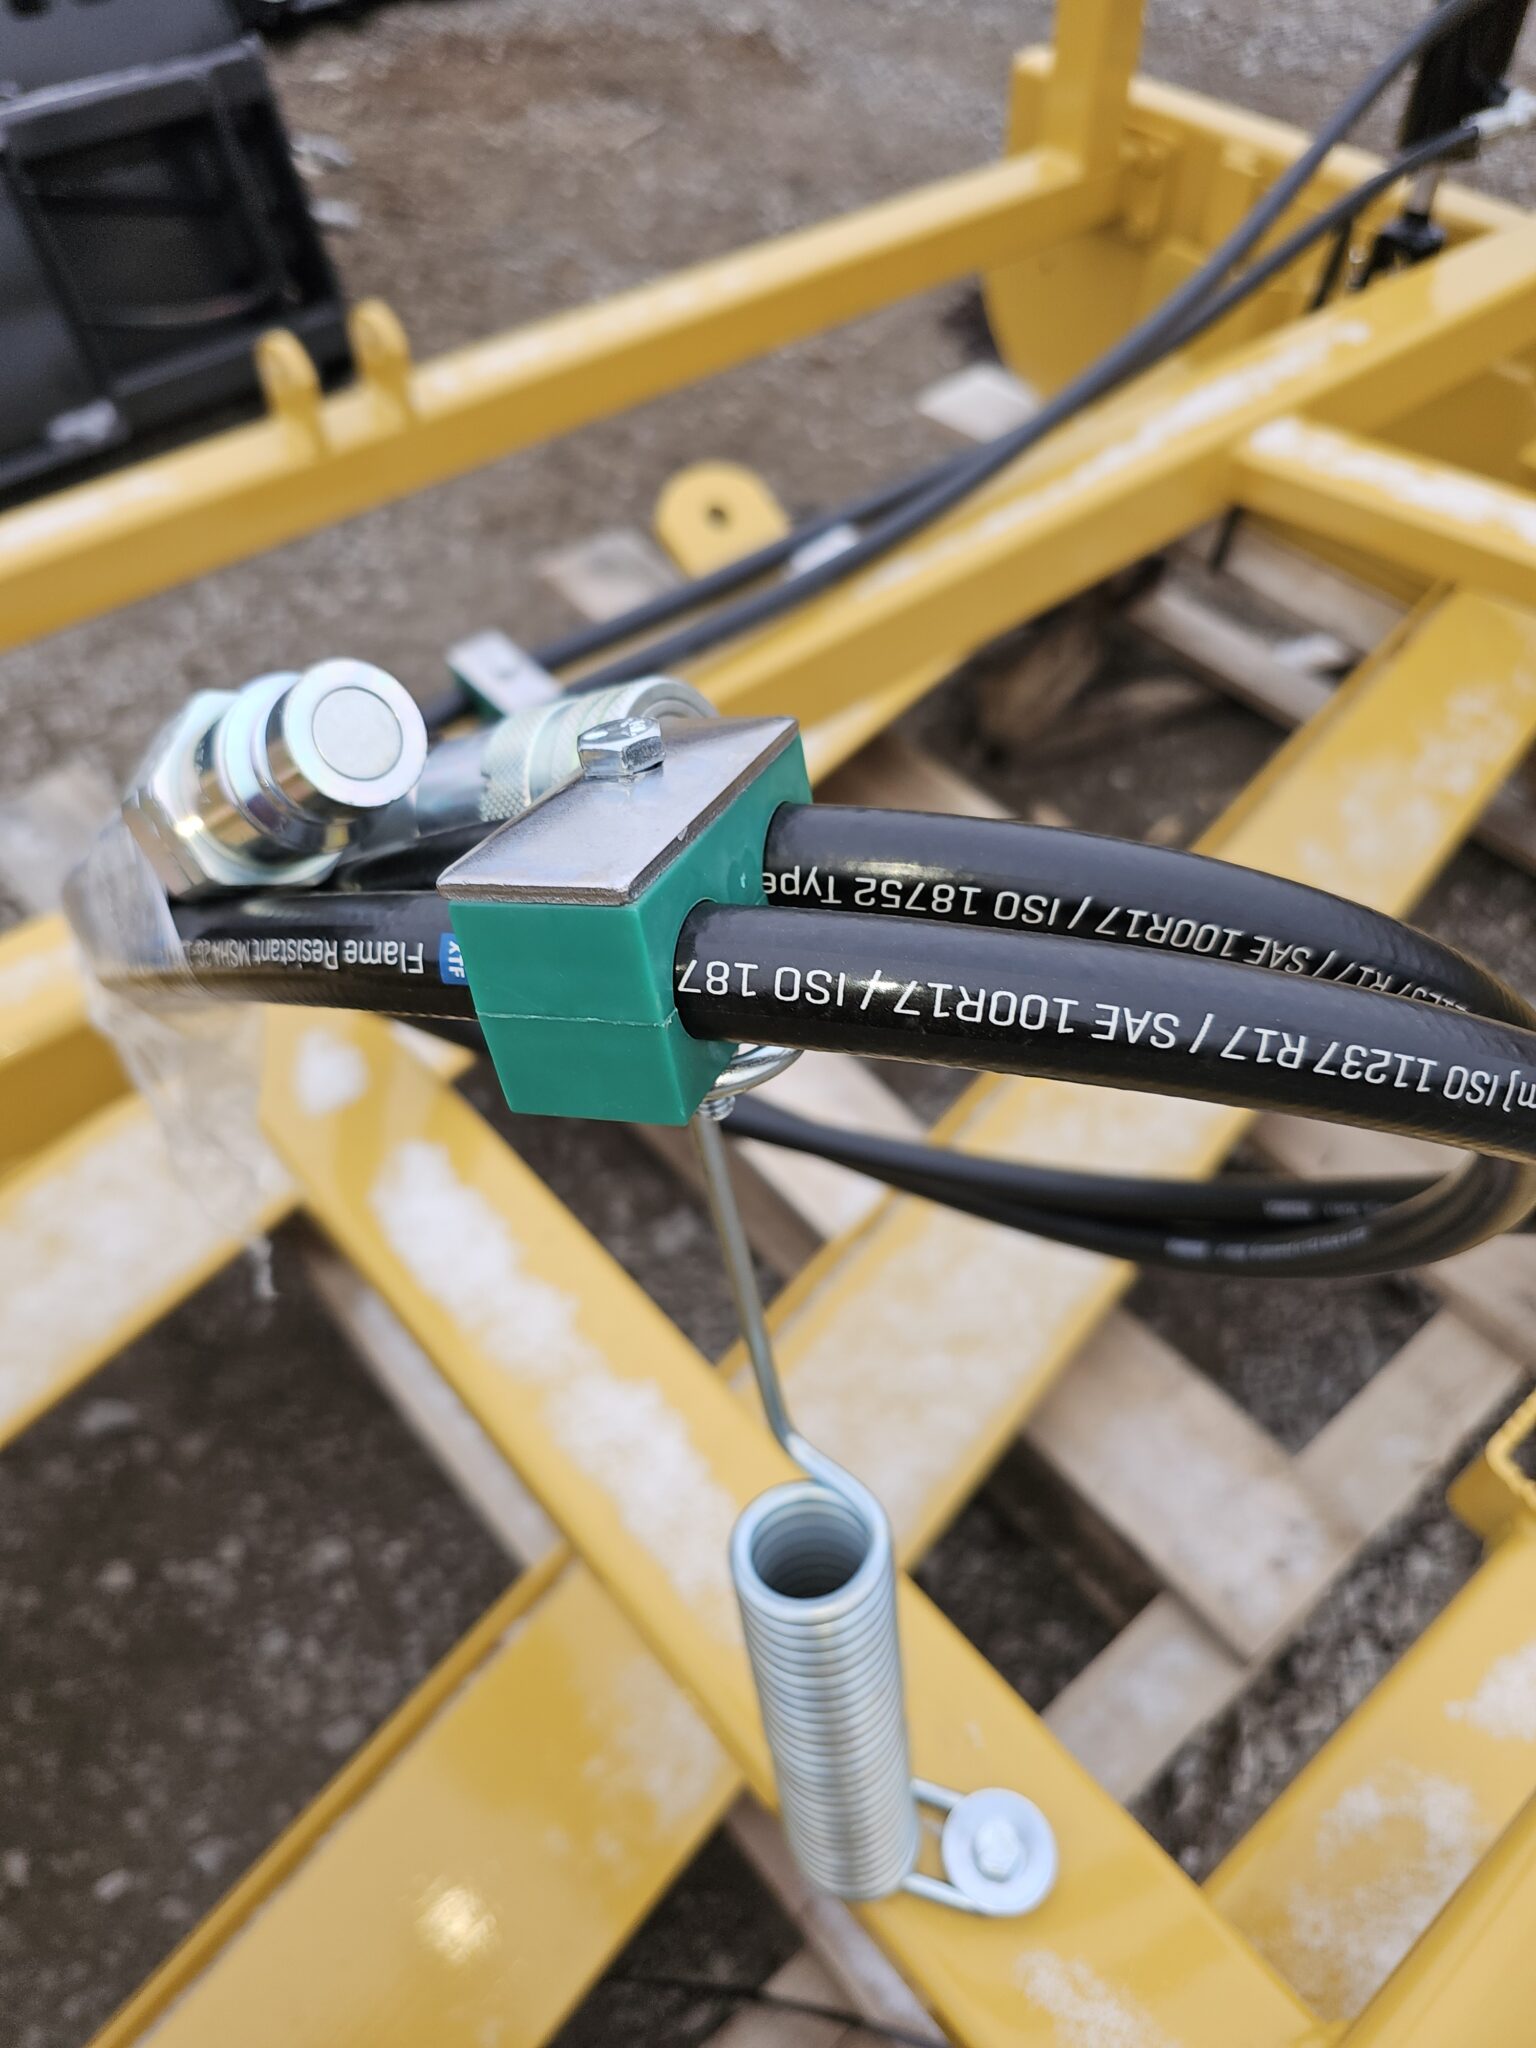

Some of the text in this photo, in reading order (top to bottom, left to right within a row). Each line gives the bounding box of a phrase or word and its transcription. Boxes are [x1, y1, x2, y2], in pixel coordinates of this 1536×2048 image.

[762, 865, 842, 904] Type
[853, 877, 983, 915] 18752
[993, 891, 1060, 926] ISO
[1067, 896, 1093, 929] /
[1095, 906, 1246, 957] 100R17
[252, 938, 339, 970] Resistant
[343, 939, 424, 974] Flame
[1243, 935, 1313, 973] SAE
[774, 966, 846, 1006] ISO
[859, 969, 882, 1010] /
[892, 980, 1079, 1034] 100R17
[1091, 1003, 1180, 1049] SAE
[1188, 1012, 1214, 1054] /
[1219, 1025, 1307, 1069] R17
[1312, 1041, 1438, 1092] 11237
[1442, 1065, 1499, 1106] ISO
